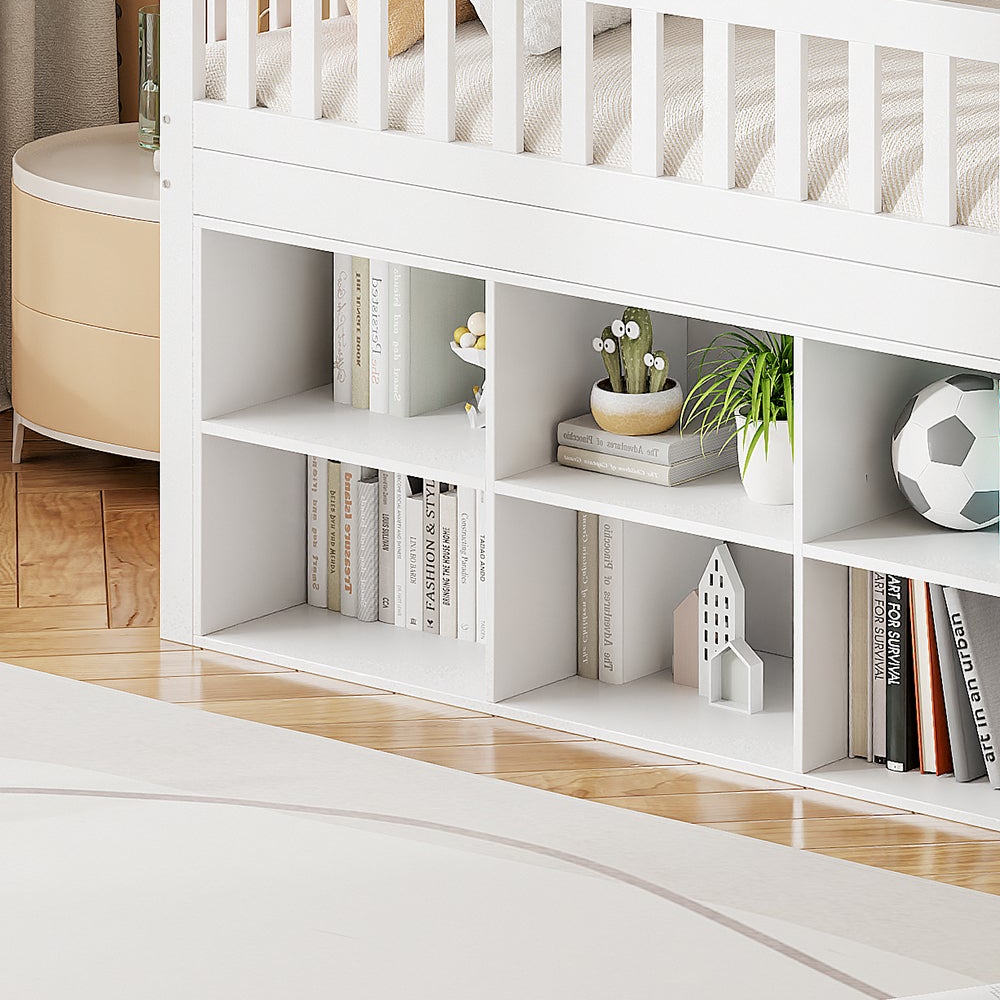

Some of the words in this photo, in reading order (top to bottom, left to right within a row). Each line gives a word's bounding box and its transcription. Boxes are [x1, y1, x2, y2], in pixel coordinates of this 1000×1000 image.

[425, 479, 436, 519] STYL
[425, 523, 435, 535] &
[442, 526, 450, 544] HOME
[460, 512, 469, 555] Constructing
[442, 544, 450, 564] HOUSE
[425, 539, 435, 611] FASHION
[442, 565, 450, 576] THE
[442, 577, 451, 606] BRINGING
[874, 572, 885, 595] ART
[887, 575, 901, 600] ART
[382, 597, 390, 609] CCA
[874, 599, 885, 624] FOR
[887, 602, 901, 628] FOR
[874, 627, 885, 680] SURVIVAL
[950, 612, 974, 671] urban
[887, 631, 901, 685] SURVIVAL
[967, 678, 981, 702] an
[974, 708, 987, 728] in
[980, 733, 996, 763] art
